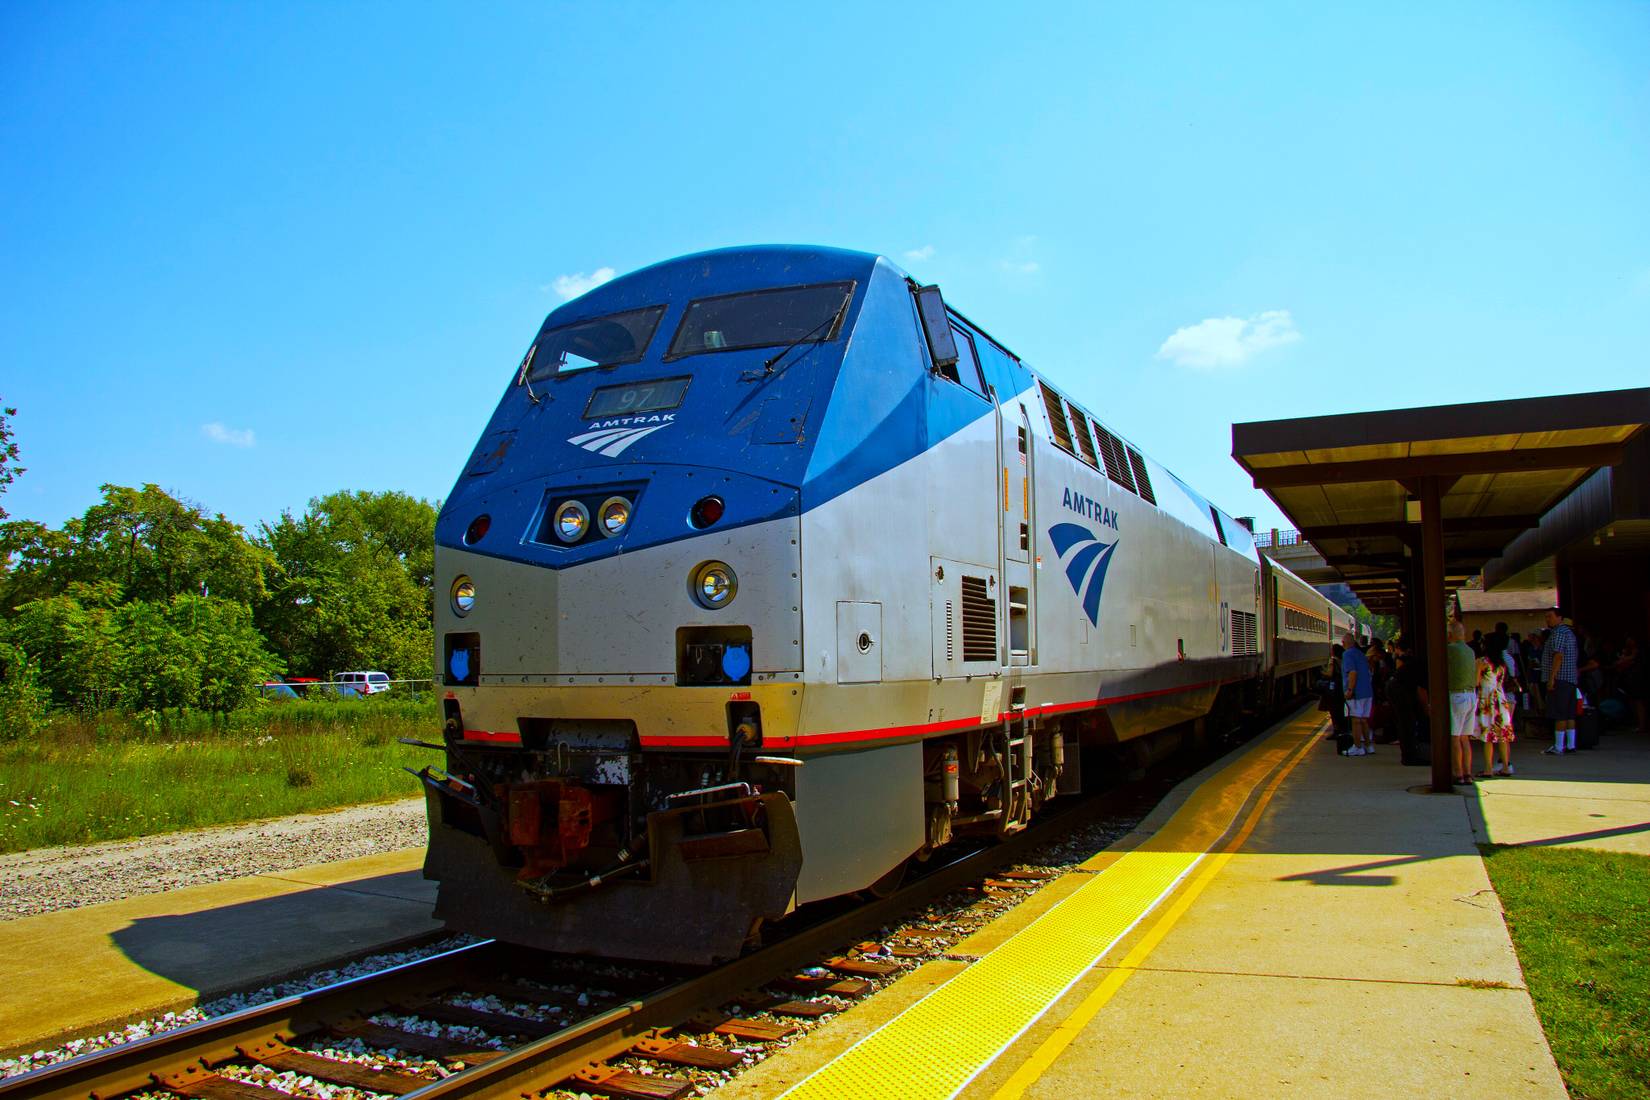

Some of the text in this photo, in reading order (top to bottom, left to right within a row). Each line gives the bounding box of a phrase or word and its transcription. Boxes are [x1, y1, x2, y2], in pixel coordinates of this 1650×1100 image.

[618, 387, 656, 410] 97
[588, 413, 677, 430] AMTRAK
[1062, 487, 1119, 531] AMTRAK
[1220, 601, 1229, 652] 97
